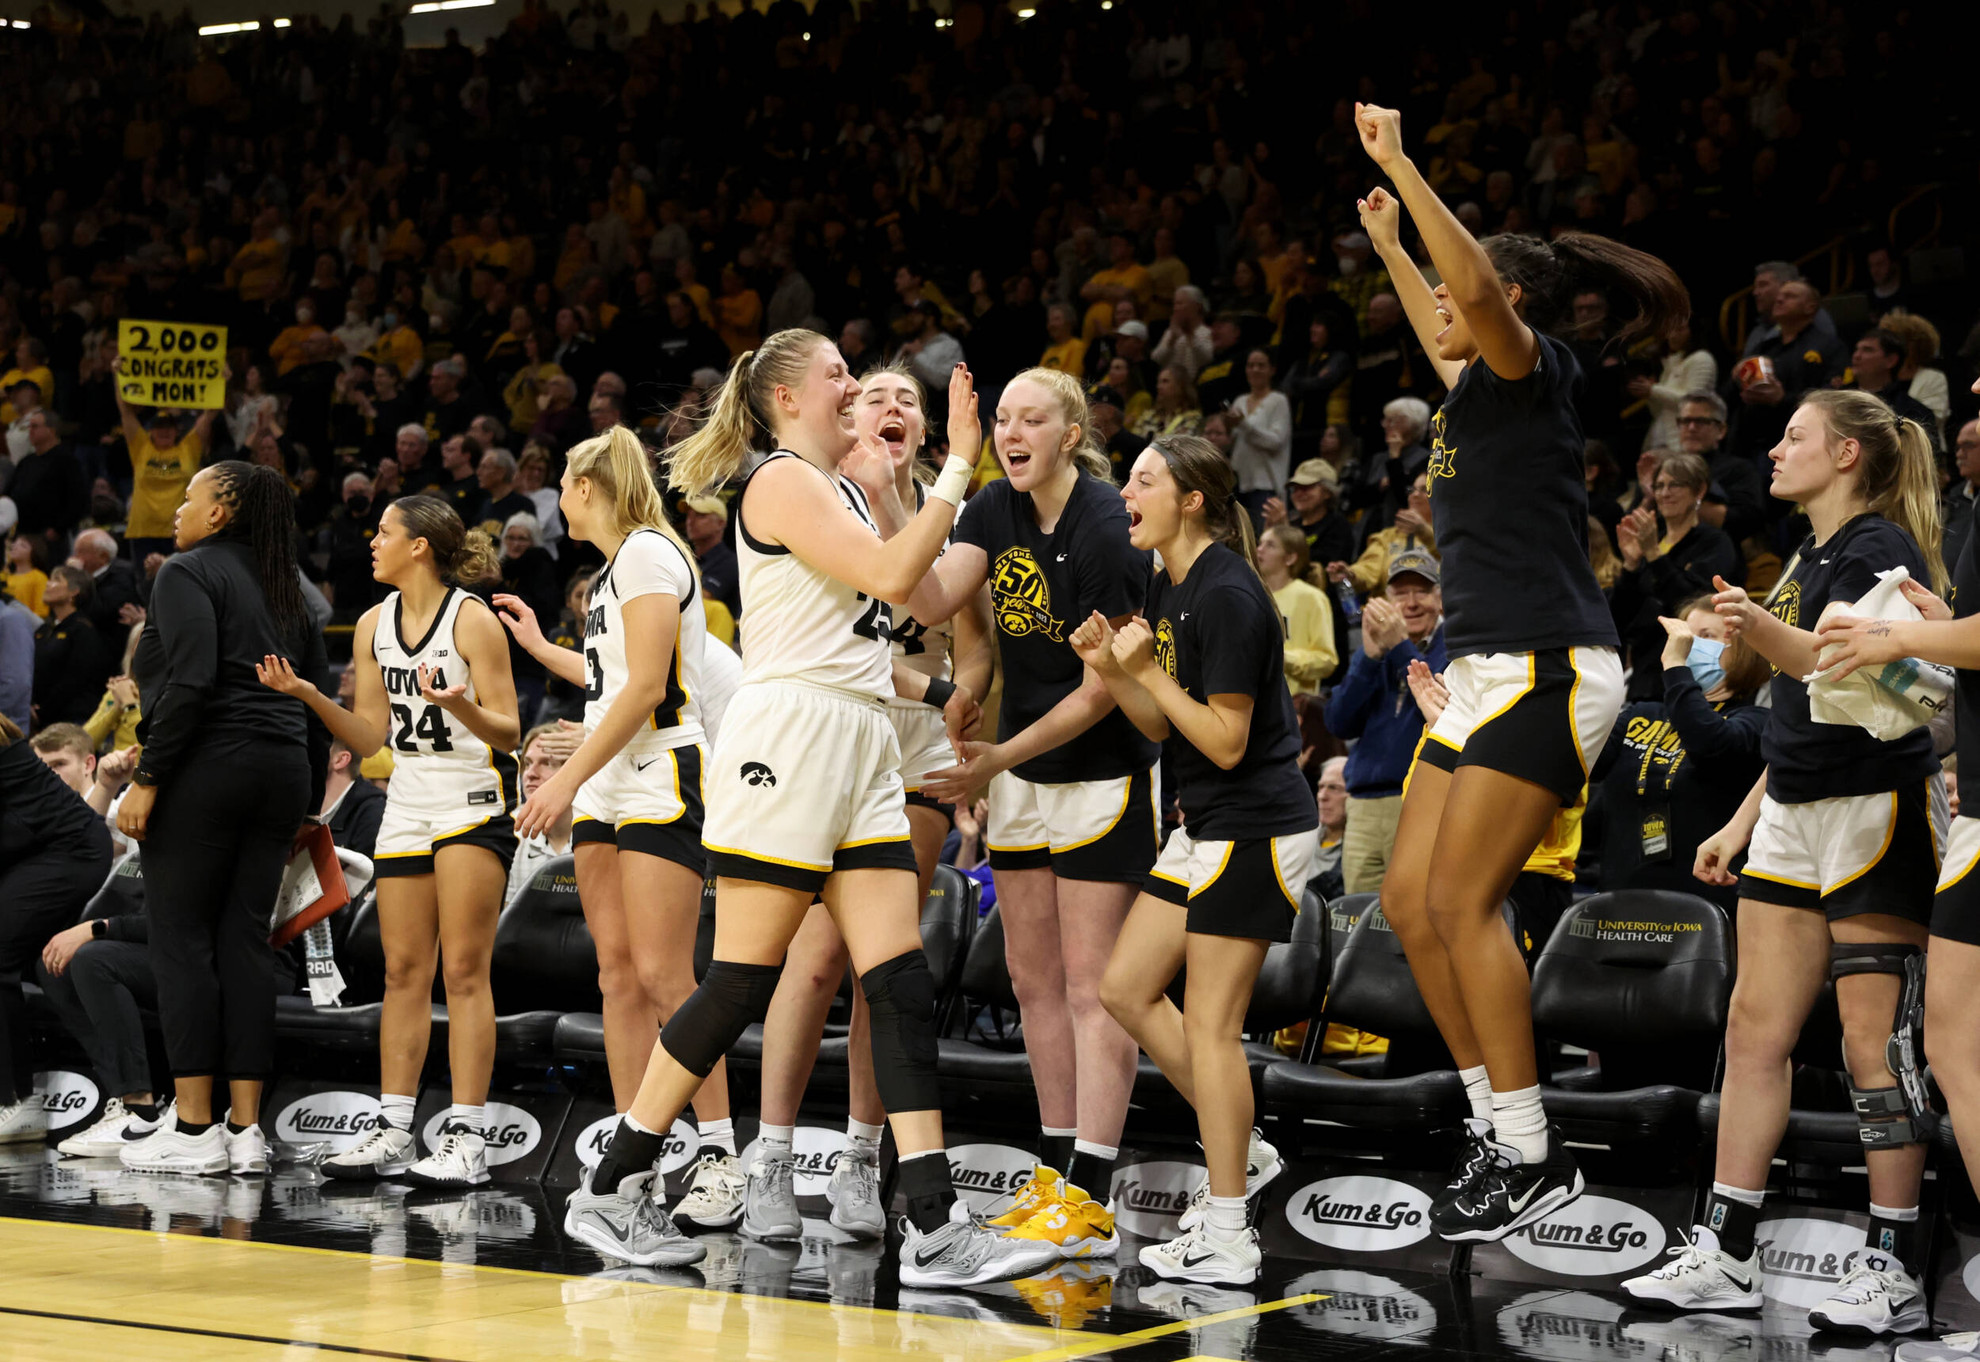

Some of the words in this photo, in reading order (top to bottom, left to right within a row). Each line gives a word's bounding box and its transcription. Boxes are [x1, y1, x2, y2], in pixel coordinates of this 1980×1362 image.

[129, 326, 219, 355] 2,000
[119, 357, 219, 379] CONGRATS
[391, 703, 454, 752] 24
[1597, 931, 1641, 941] HEALTH
[1644, 932, 1674, 943] CARE
[1599, 920, 1660, 931] UNIVERSITY
[1673, 922, 1702, 932] IOWA
